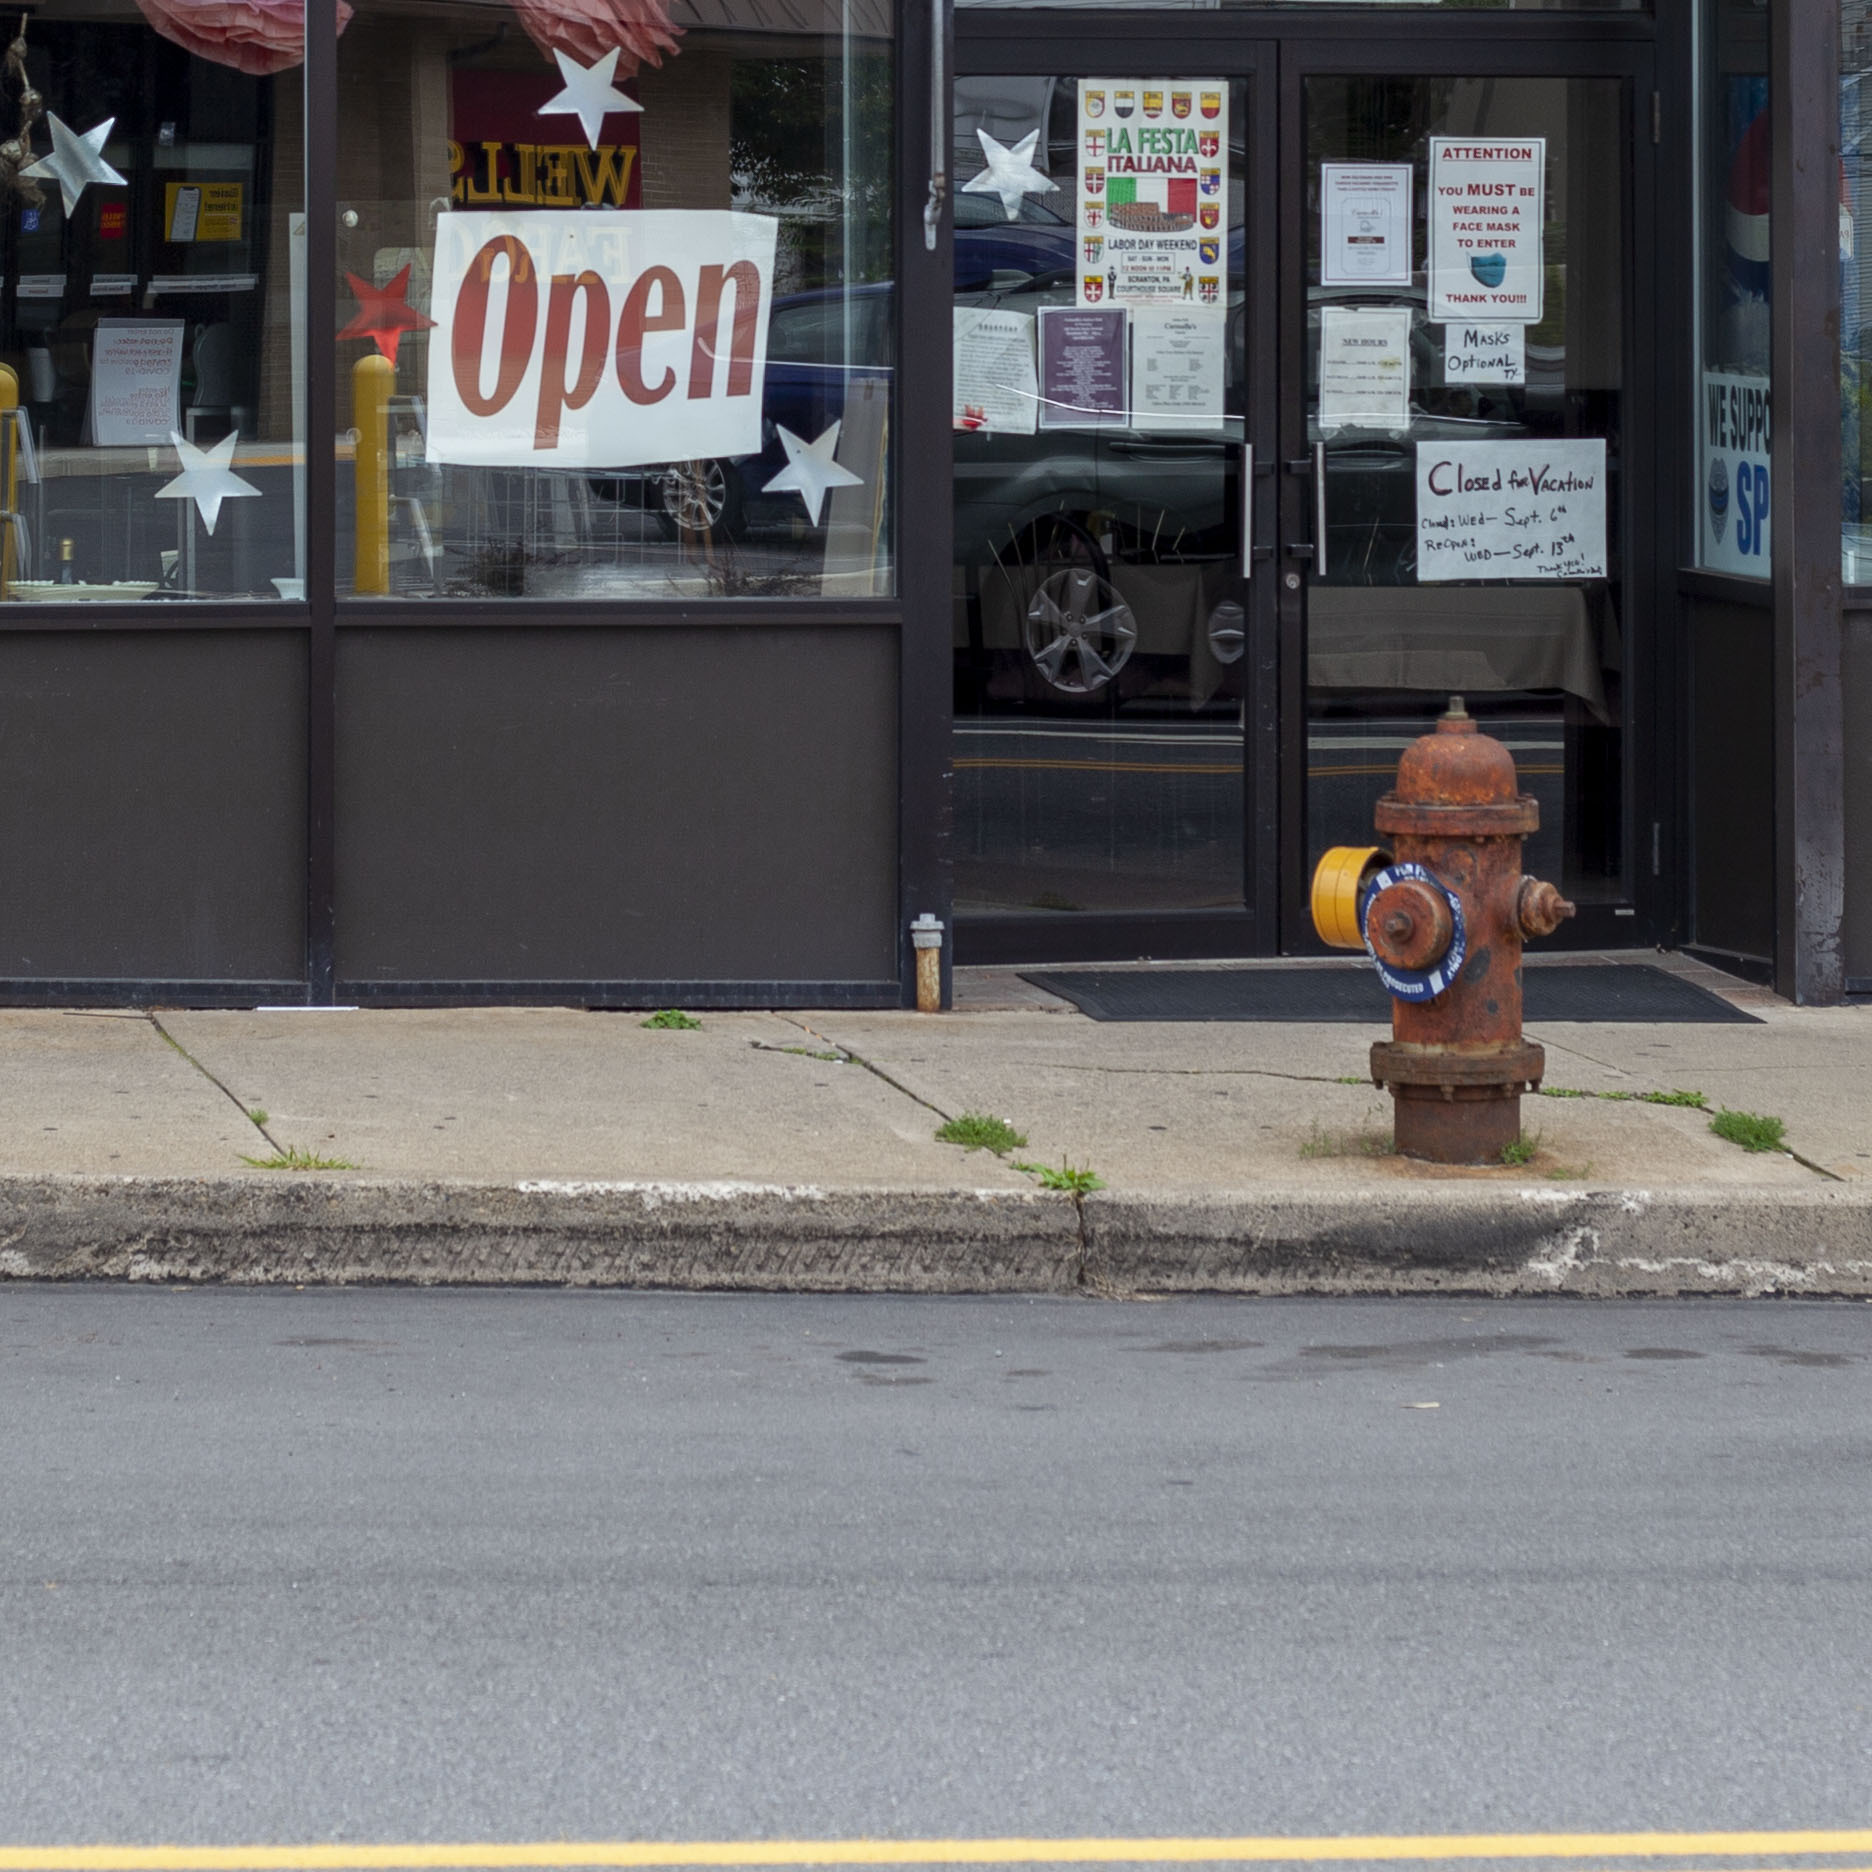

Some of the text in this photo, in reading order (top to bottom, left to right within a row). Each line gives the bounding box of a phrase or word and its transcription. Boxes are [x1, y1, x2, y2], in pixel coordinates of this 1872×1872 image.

[1106, 127, 1199, 155] LA FESTA
[1442, 147, 1532, 160] ATTENTION
[1107, 155, 1198, 173] ITALIANA
[1438, 183, 1535, 197] YOU MUST BE
[1452, 205, 1521, 216] WEARING A
[1452, 222, 1521, 232] FACE MASK
[1108, 239, 1198, 251] LABOR DAY WEEKEND
[1456, 238, 1517, 249] TO ENTER
[1445, 293, 1528, 305] THANK YOU!!!
[451, 234, 761, 451] Open
[1708, 383, 1727, 448] WE
